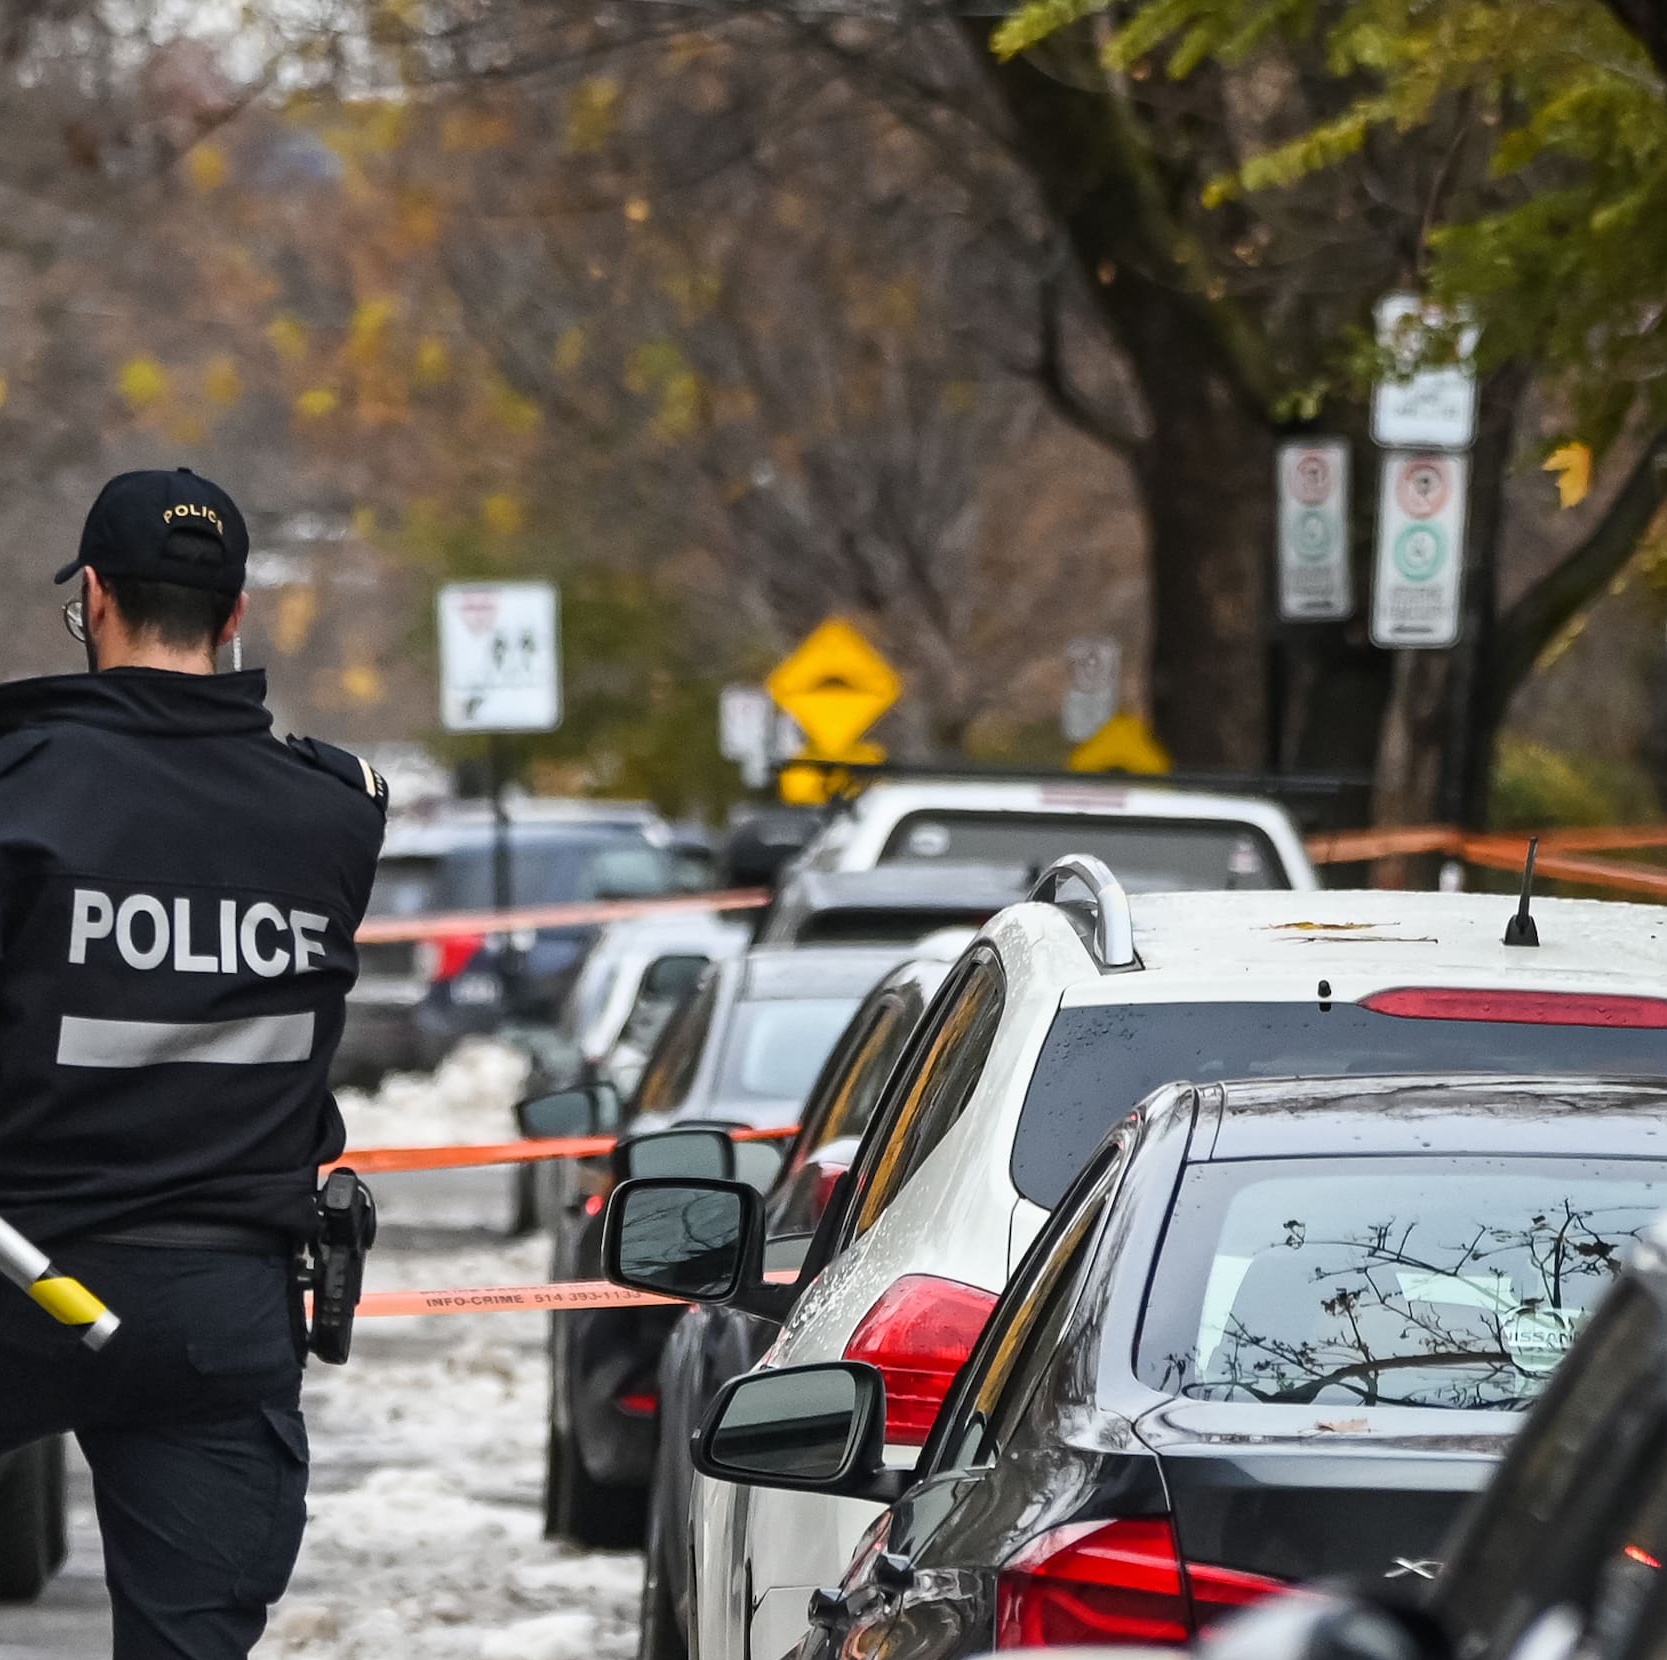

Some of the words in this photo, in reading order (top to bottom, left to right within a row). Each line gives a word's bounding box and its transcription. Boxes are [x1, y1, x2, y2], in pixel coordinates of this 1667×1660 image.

[67, 887, 330, 978] POLICE
[426, 1295, 525, 1308] INFO-CRIME
[534, 1293, 564, 1304] 514
[568, 1289, 643, 1303] 393-1133
